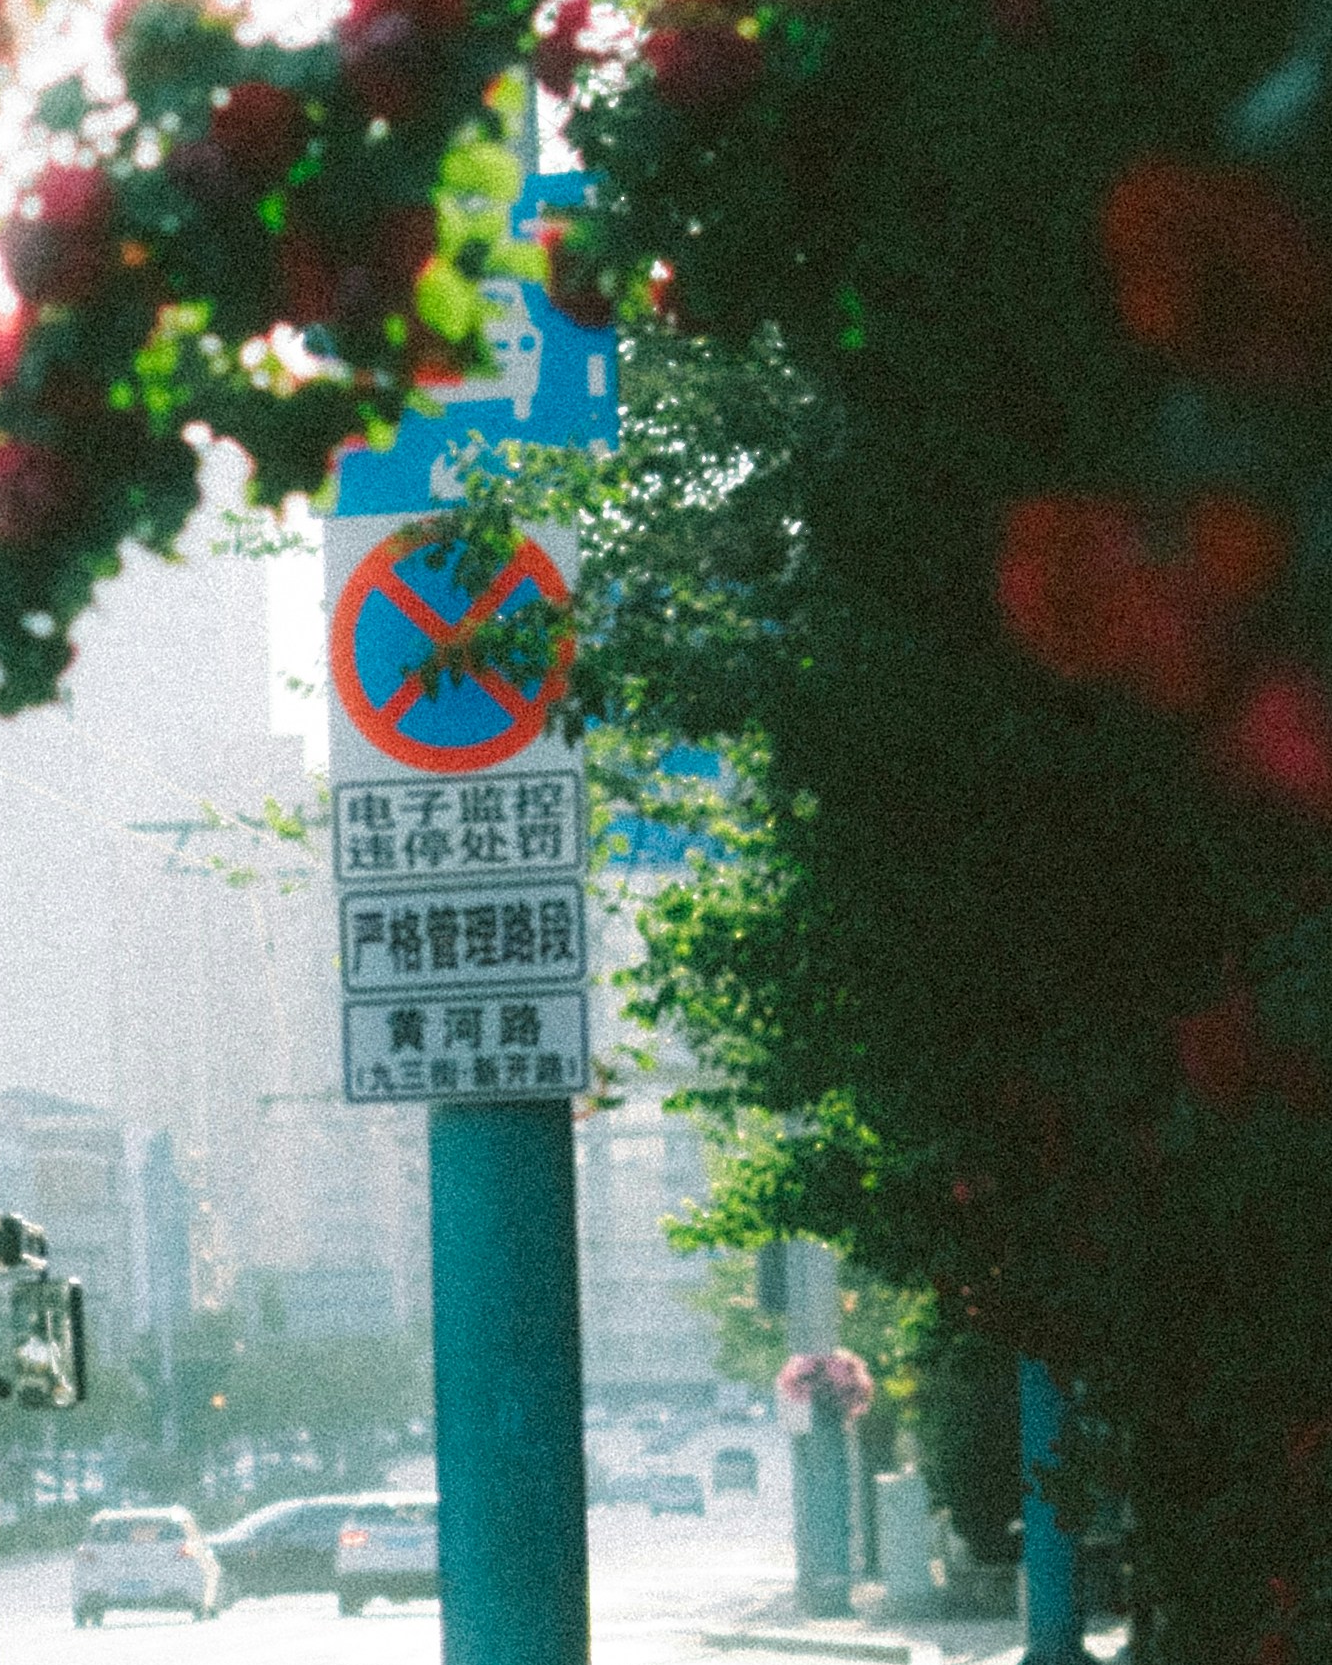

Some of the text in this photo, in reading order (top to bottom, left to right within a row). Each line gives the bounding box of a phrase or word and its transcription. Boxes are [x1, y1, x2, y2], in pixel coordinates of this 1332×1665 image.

[347, 782, 565, 830] 电子监控
[347, 825, 565, 869] 违停处罚
[353, 900, 573, 973] 严格管理路段
[388, 1004, 542, 1052] 黄河路
